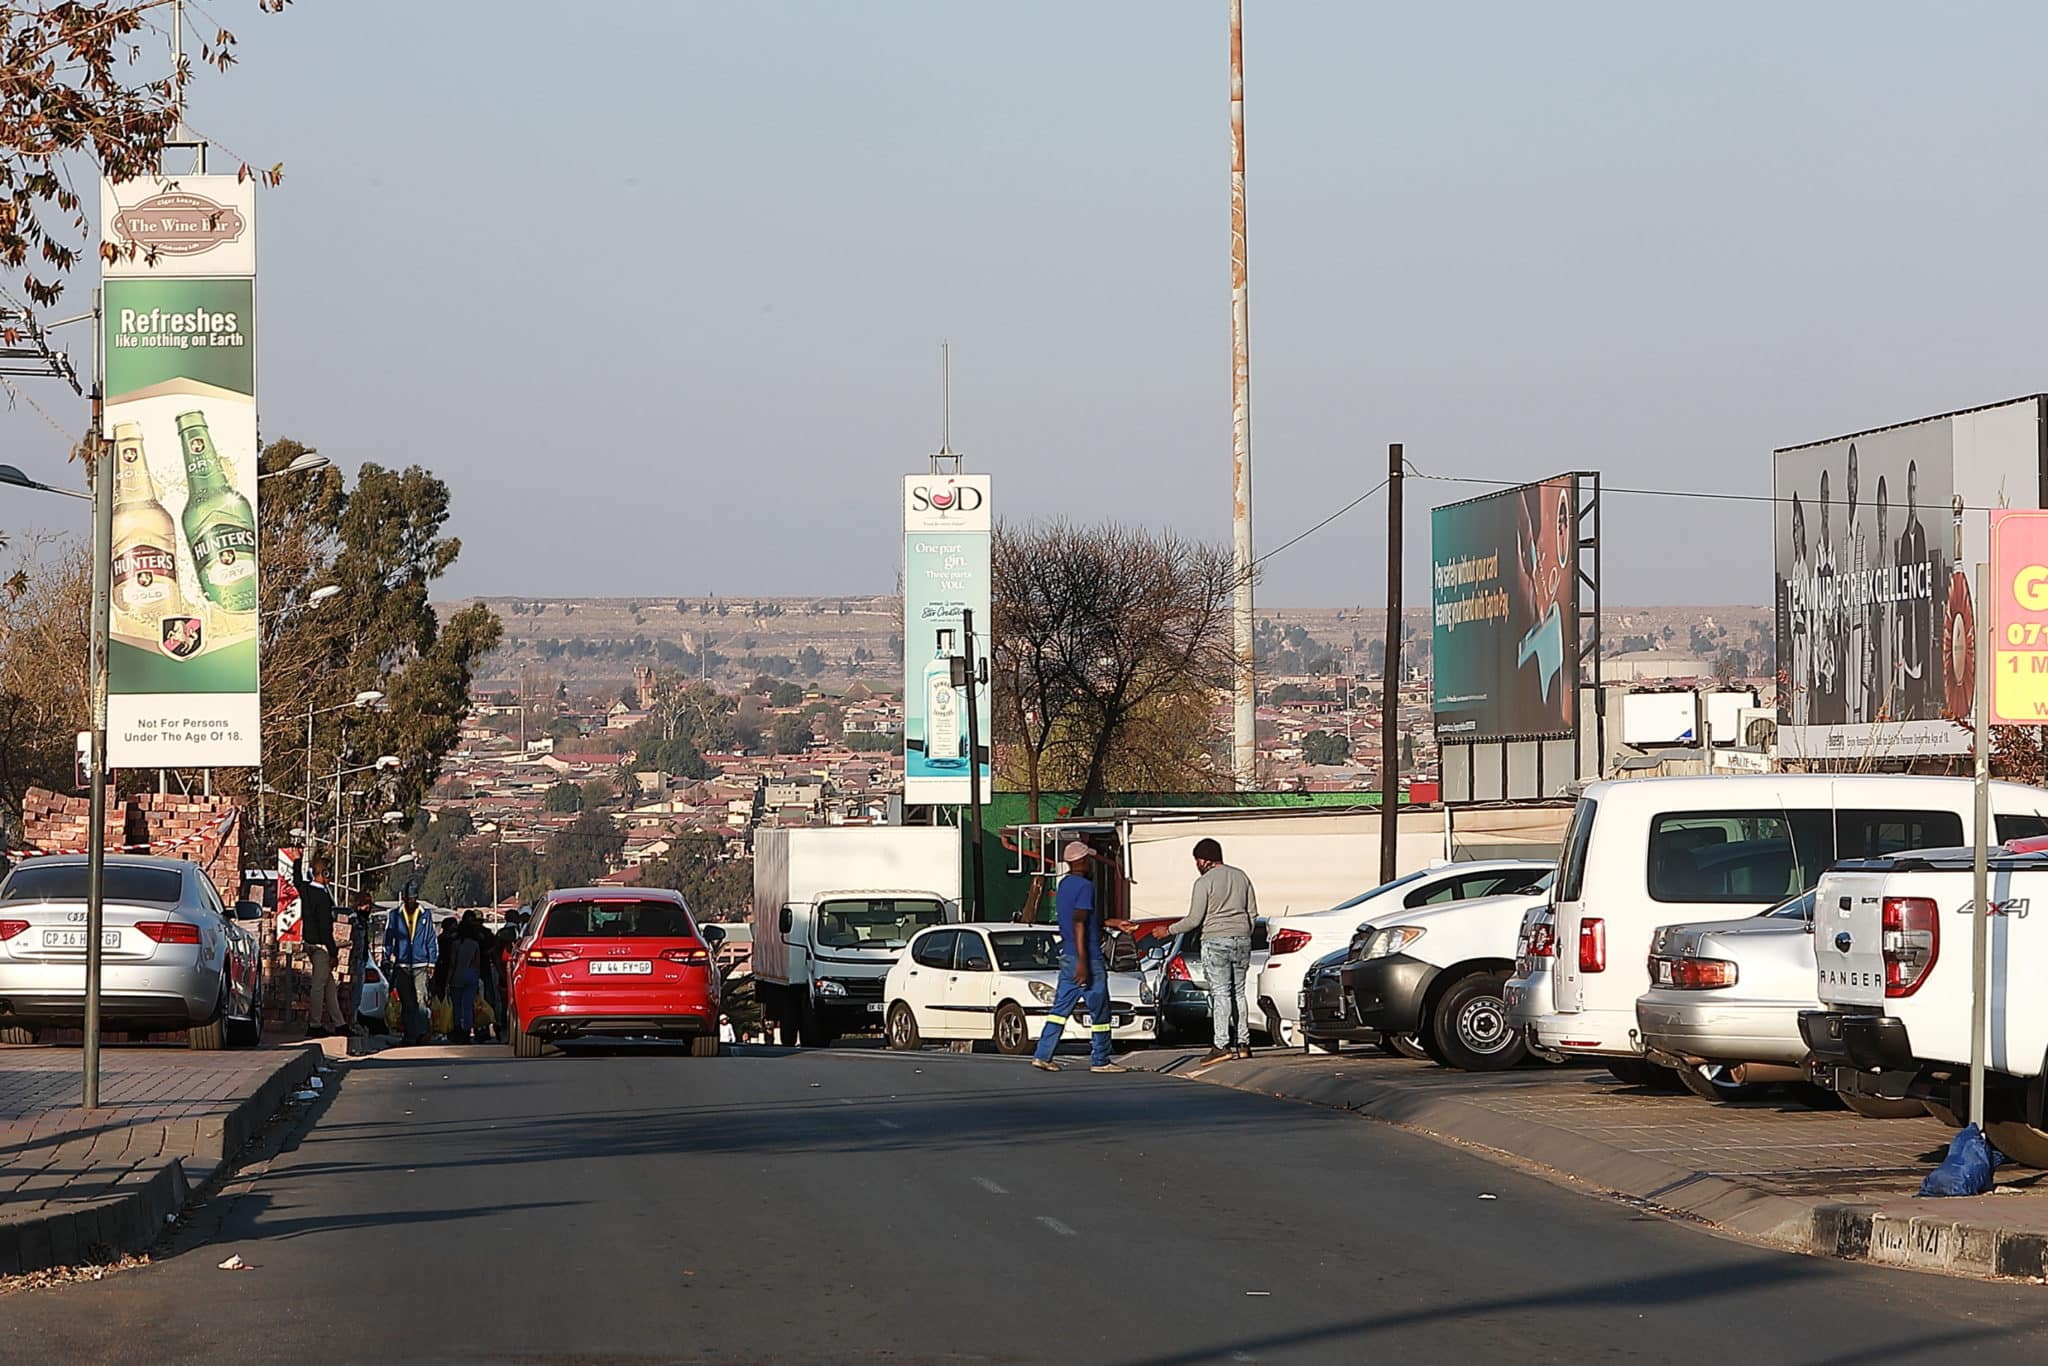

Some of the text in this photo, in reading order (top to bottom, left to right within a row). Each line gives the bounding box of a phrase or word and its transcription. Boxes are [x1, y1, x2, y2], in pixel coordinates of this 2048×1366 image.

[129, 218, 157, 232] The
[161, 218, 198, 232] Wine
[121, 307, 237, 333] Refreshes
[115, 333, 243, 349] like nothing on Earth
[188, 458, 217, 473] DRY
[915, 543, 961, 556] One part
[1786, 577, 1814, 612] TEAM
[1836, 573, 1857, 610] FOR
[1861, 562, 1932, 605] EXCELLENCE
[2008, 655, 2018, 673] 1
[138, 718, 229, 728] Not For Persons
[124, 731, 243, 743] Under The Age Of 18.
[46, 933, 59, 945] CP
[63, 933, 75, 945] 16
[105, 934, 118, 945] GP
[607, 962, 617, 972] 44
[639, 962, 650, 972] GP
[1820, 970, 1882, 987] RANGER
